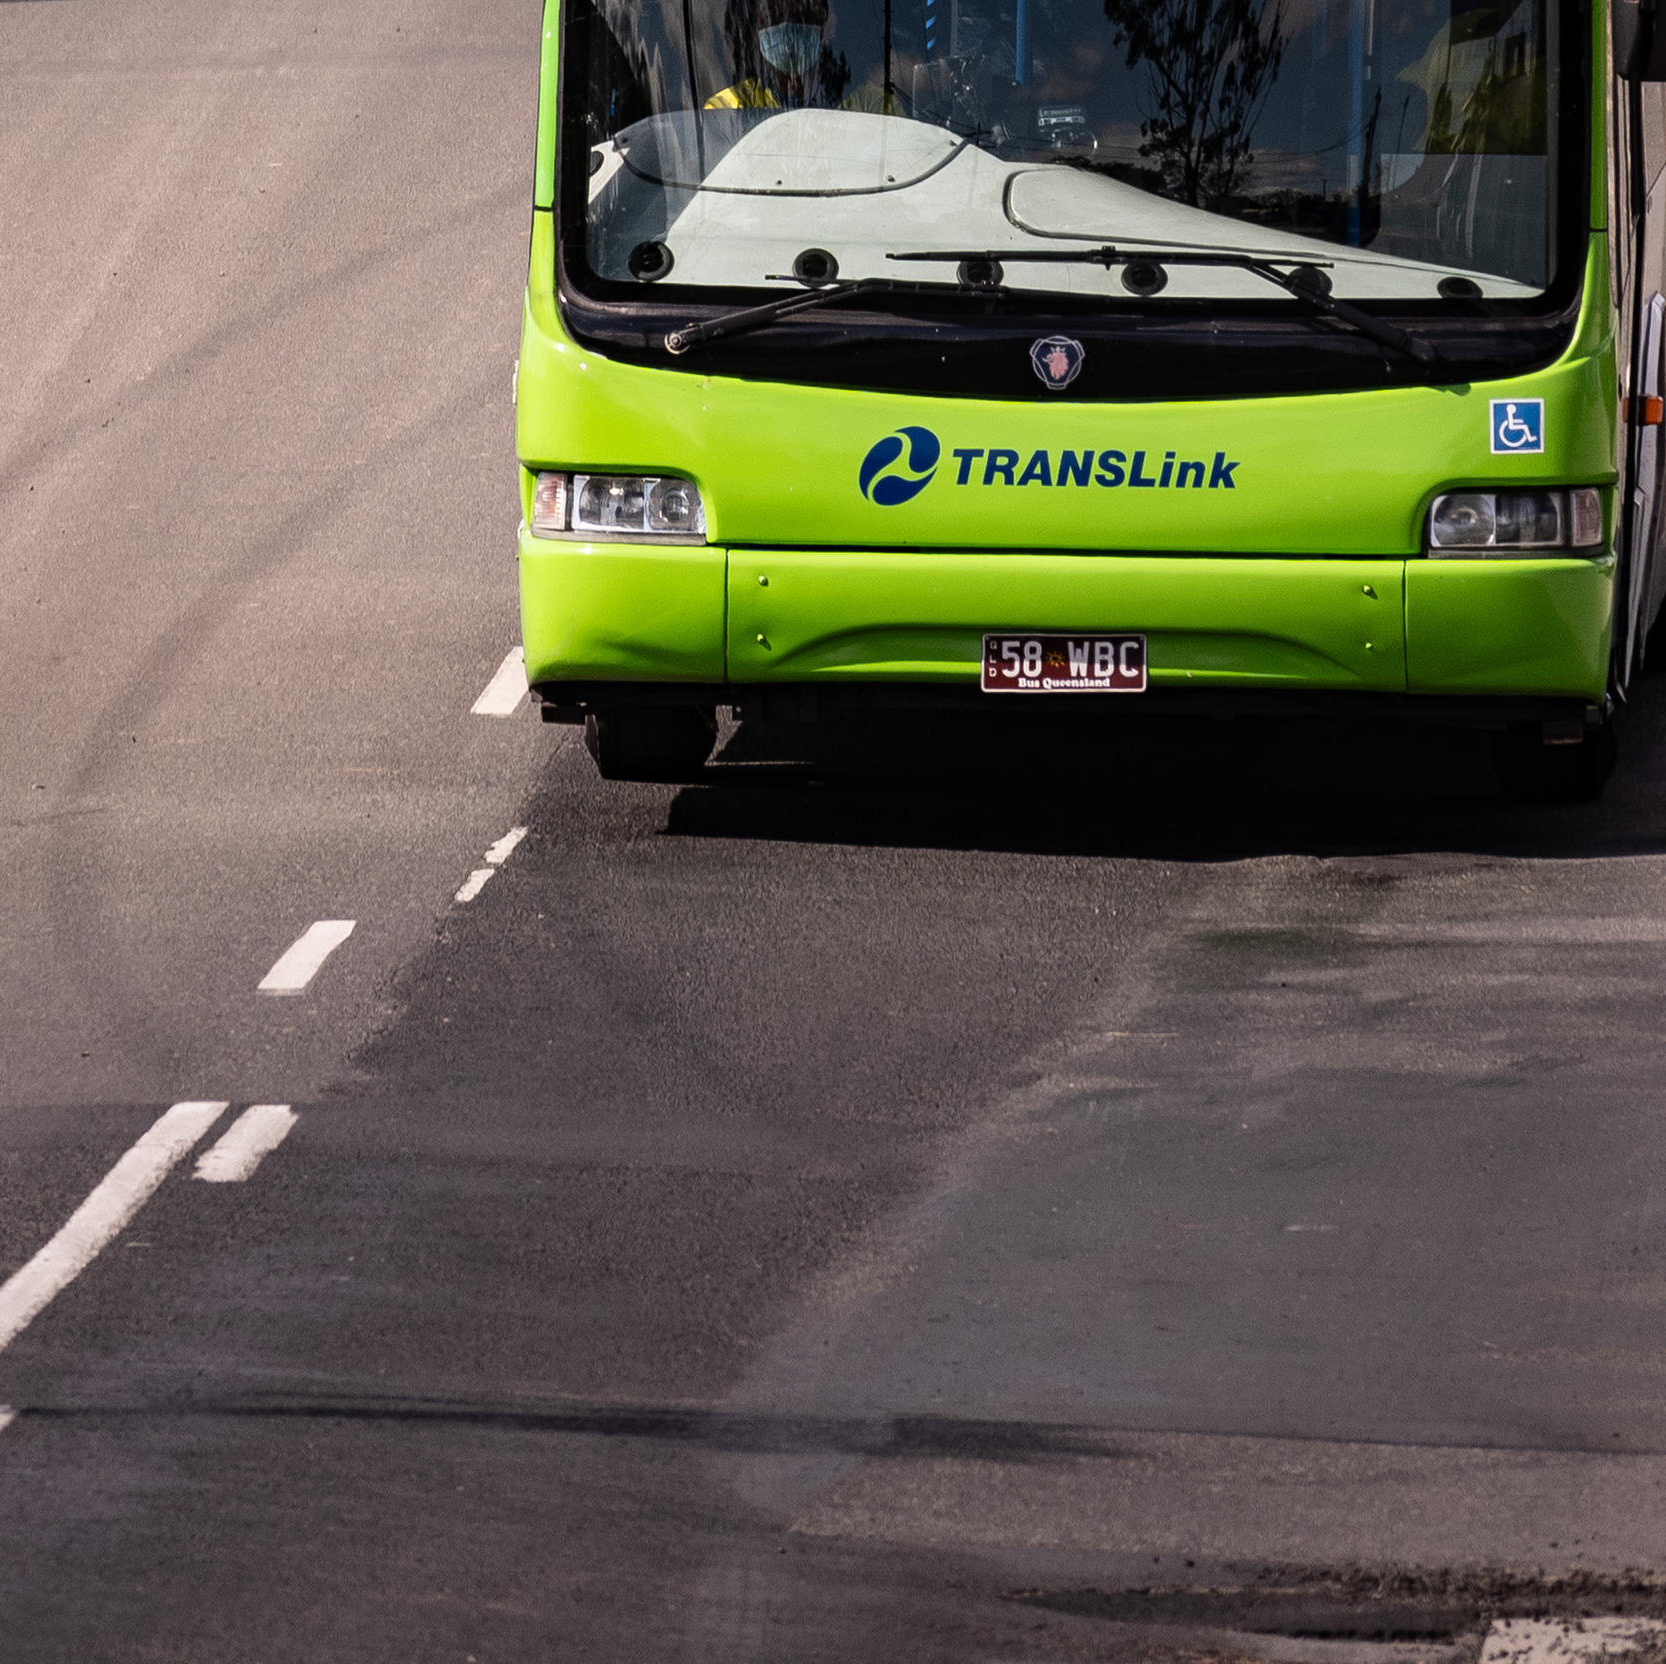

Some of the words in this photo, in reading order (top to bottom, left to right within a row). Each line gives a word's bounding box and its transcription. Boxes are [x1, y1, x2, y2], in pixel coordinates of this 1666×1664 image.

[952, 448, 1241, 489] TRANSLink
[1001, 641, 1043, 678] 58
[1067, 641, 1140, 678] WBC
[1018, 677, 1041, 688] Bus
[1042, 677, 1111, 689] Queensland
